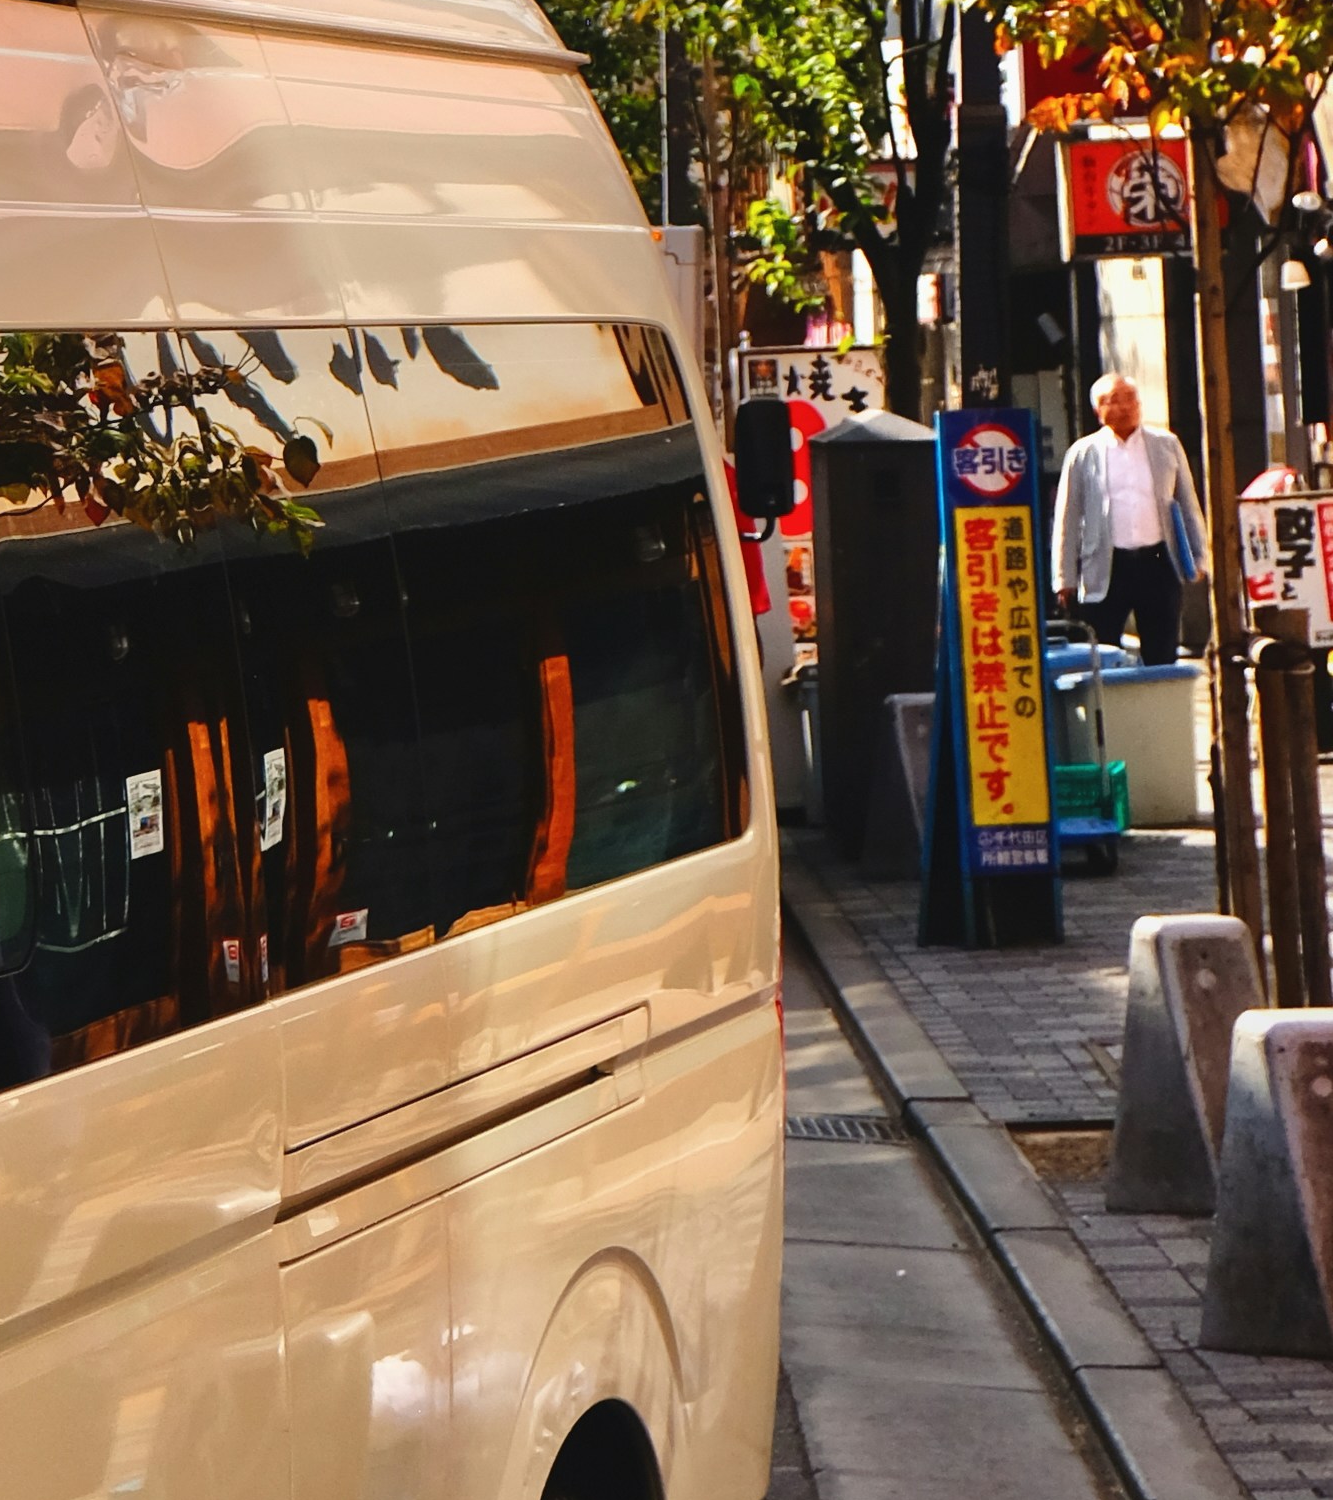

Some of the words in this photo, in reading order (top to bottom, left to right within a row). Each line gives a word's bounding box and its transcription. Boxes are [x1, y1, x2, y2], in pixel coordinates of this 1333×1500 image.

[954, 446, 1027, 476] 客引き
[964, 517, 1014, 815] 客引きは禁止です。
[1002, 516, 1037, 719] 道路や広場での
